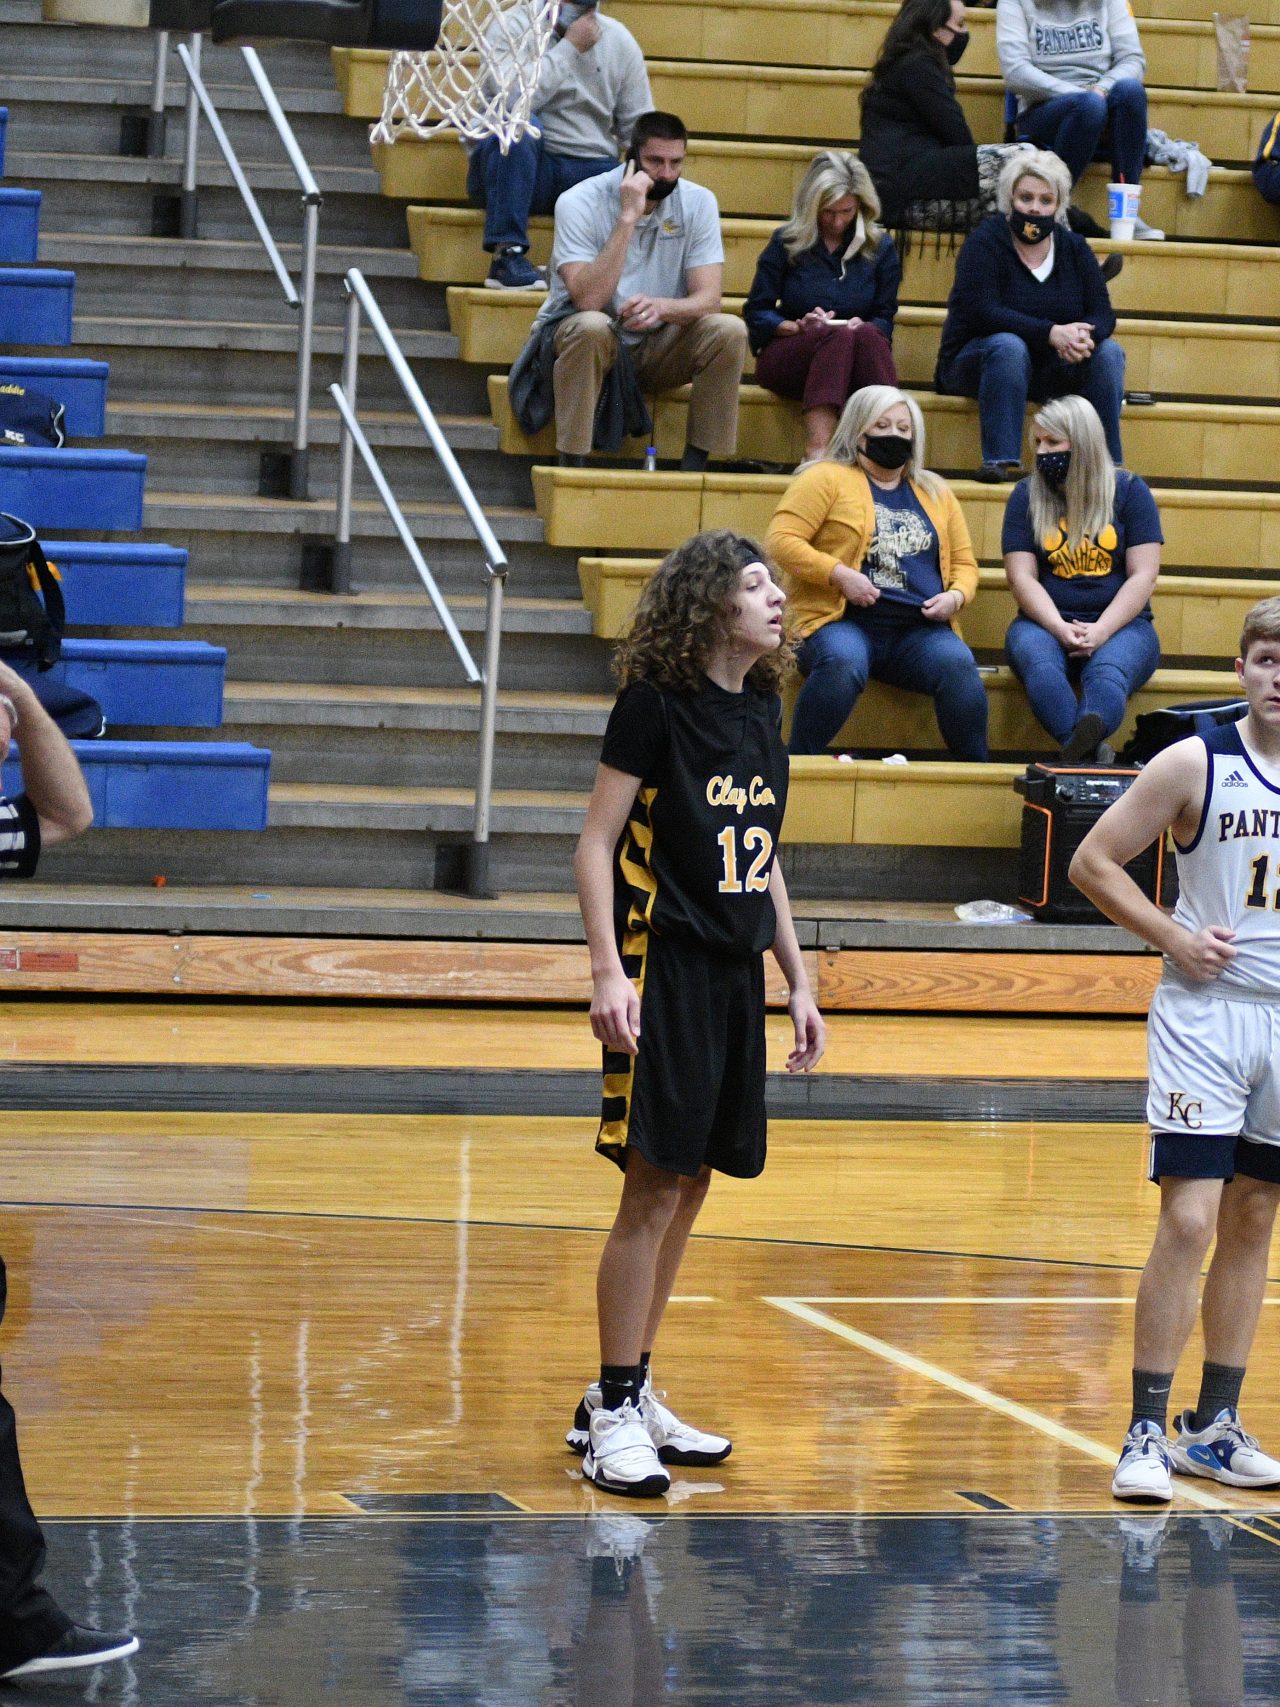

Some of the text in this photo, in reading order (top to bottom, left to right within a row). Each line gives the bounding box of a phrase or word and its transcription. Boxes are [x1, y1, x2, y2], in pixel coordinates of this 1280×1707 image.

[1035, 18, 1104, 55] PANTHERS
[706, 775, 748, 814] Clay
[1221, 780, 1249, 788] adidas
[717, 826, 773, 893] 12
[1166, 1092, 1202, 1130] KC
